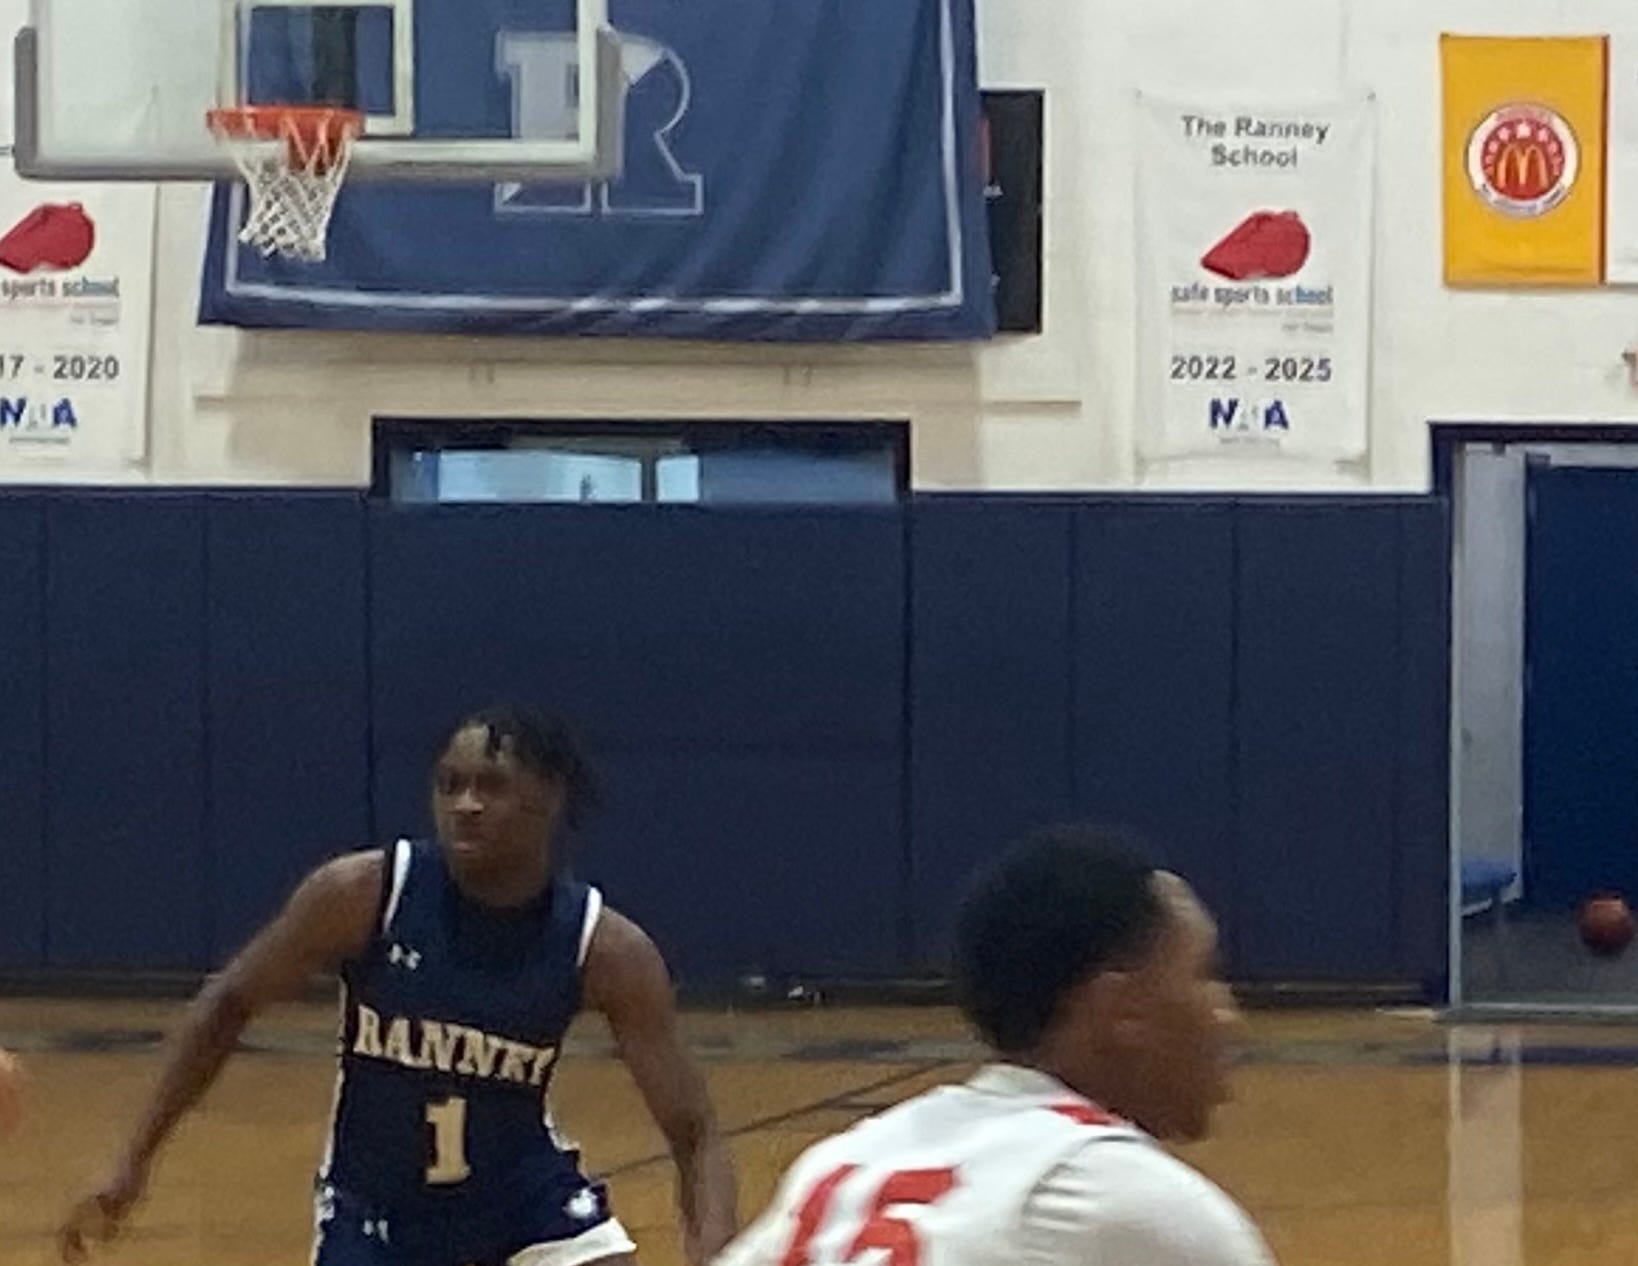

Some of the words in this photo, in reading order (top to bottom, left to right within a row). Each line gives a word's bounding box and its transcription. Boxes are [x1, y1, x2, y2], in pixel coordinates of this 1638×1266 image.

[1182, 115, 1226, 138] The
[1234, 116, 1329, 144] Ranney
[1211, 144, 1298, 167] School
[62, 276, 119, 297] school
[1172, 282, 1207, 302] safe
[1214, 285, 1269, 309] sports
[53, 355, 119, 379] 2020
[1171, 355, 1237, 380] 2022
[1264, 358, 1332, 381] 2025
[353, 1004, 555, 1087] RANNEY
[425, 1096, 471, 1184] 1
